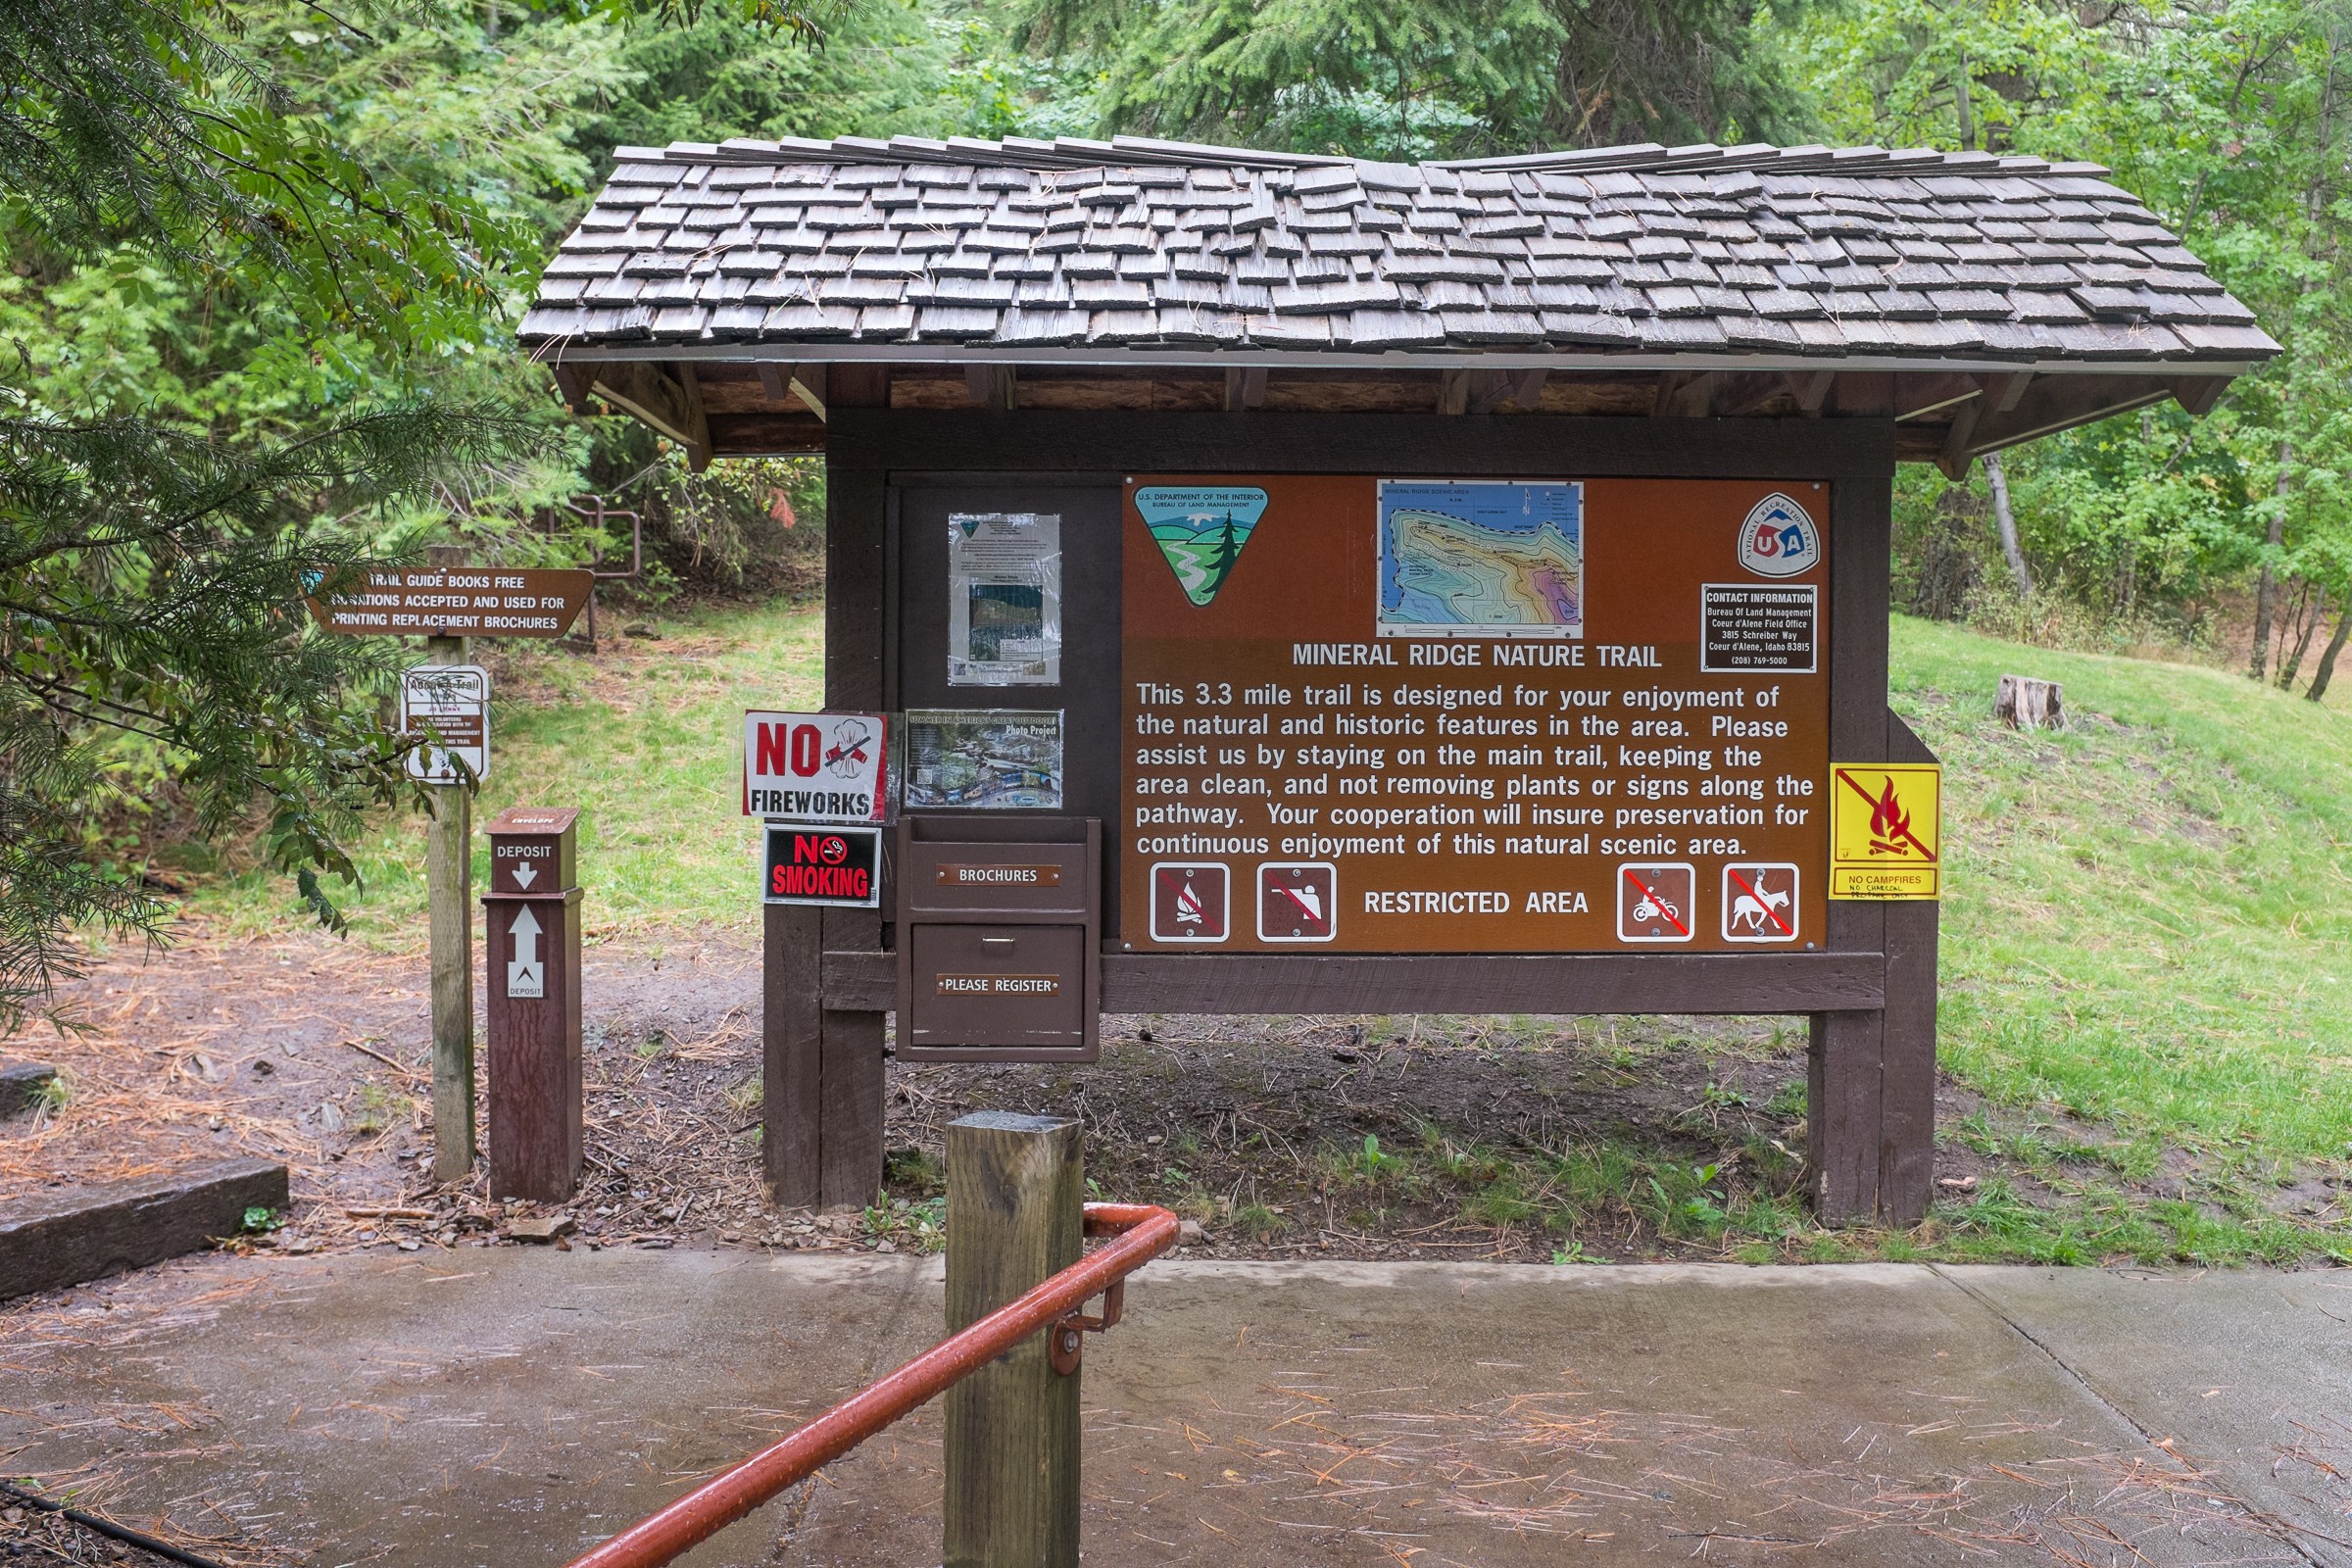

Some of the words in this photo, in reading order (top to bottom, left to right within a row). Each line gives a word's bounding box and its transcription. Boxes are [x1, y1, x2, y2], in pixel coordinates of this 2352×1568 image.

[1746, 520, 1760, 560] NATIONAL
[1760, 501, 1803, 526] RECREATION
[1803, 530, 1813, 557] TRAIL
[1757, 532, 1801, 556] USA
[369, 573, 402, 586] TRAIL
[407, 574, 443, 587] GUIDE
[448, 575, 490, 588] BOOKS
[494, 576, 525, 588] FREE
[405, 595, 468, 608] ACCEPTED
[473, 596, 499, 608] AND
[504, 597, 536, 609] USED
[541, 597, 564, 609] FOR
[1706, 593, 1748, 603] CONTACT
[1750, 593, 1813, 603] INFORMATION
[332, 612, 387, 625] PRINTING
[392, 613, 480, 626] REPLACEMENT
[484, 615, 558, 629] BROCHURES
[1745, 608, 1763, 616] Land
[1766, 609, 1811, 618] Management
[1722, 630, 1739, 639] 3815
[1782, 631, 1797, 641] Way
[1293, 643, 1398, 665] MINERAL
[1409, 644, 1482, 666] RIDGE
[1494, 644, 1586, 667] NATURE
[1595, 645, 1663, 667] TRAIL
[1733, 642, 1763, 652] d'Alene,
[1765, 642, 1785, 651] Idaho
[1732, 656, 1750, 664] (208)
[1136, 682, 1184, 705] This
[1196, 682, 1233, 706] 3.3
[1244, 683, 1292, 706] mile
[1303, 683, 1351, 706] trail
[1363, 683, 1382, 706] is
[1393, 683, 1502, 710] designed
[1513, 684, 1549, 707] for
[1559, 690, 1612, 711] your
[1622, 685, 1744, 711] enjoyment
[1755, 685, 1780, 708] of
[909, 715, 943, 724] SUMMER
[1136, 712, 1175, 735] the
[1183, 712, 1268, 735] natural
[1280, 712, 1324, 735] and
[1336, 712, 1425, 735] historic
[1437, 712, 1538, 736] features
[1549, 713, 1569, 736] in
[1581, 714, 1620, 737] the
[1631, 719, 1690, 737] area.
[1711, 715, 1788, 738] Please
[1005, 724, 1028, 735] Photo
[1030, 724, 1057, 737] Project
[756, 722, 822, 777] NO
[1136, 743, 1207, 765] assist
[1219, 748, 1247, 765] us
[1257, 743, 1286, 769] by
[1297, 743, 1386, 770] staying
[1396, 749, 1426, 765] on
[1437, 743, 1476, 765] the
[1488, 744, 1543, 765] main
[1553, 744, 1608, 769] trail,
[1619, 744, 1713, 771] keeping
[1723, 745, 1762, 767] the
[1136, 777, 1189, 795] area
[1200, 772, 1272, 798] clean,
[1284, 772, 1328, 795] and
[1340, 774, 1379, 795] not
[1387, 773, 1495, 800] removing
[1506, 773, 1581, 800] plants
[1592, 779, 1617, 796] or
[1626, 773, 1690, 801] signs
[1700, 774, 1765, 801] along
[1775, 774, 1814, 797] the
[751, 789, 870, 816] FIREWORKS
[1136, 802, 1244, 829] pathway.
[1266, 802, 1319, 825] Your
[1330, 803, 1475, 830] cooperation
[1483, 803, 1521, 825] will
[1532, 803, 1604, 825] insure
[1615, 803, 1765, 830] preservation
[1774, 803, 1809, 825] for
[497, 846, 552, 858] DEPOSIT
[1137, 831, 1269, 855] continuous
[1281, 832, 1405, 858] enjoyment
[1416, 832, 1442, 855] of
[1452, 832, 1496, 855] this
[1505, 833, 1590, 855] natural
[1599, 833, 1677, 856] scenic
[1688, 838, 1746, 856] area.
[772, 864, 868, 898] SMOKING
[959, 869, 1038, 882] BROCHURES
[1848, 875, 1863, 884] NO
[1866, 875, 1922, 884] CAMPFIRES
[1364, 891, 1510, 914] RESTRICTED
[1525, 891, 1590, 913] AREA
[945, 979, 989, 991] PLEASE
[995, 979, 1052, 992] REGISTER
